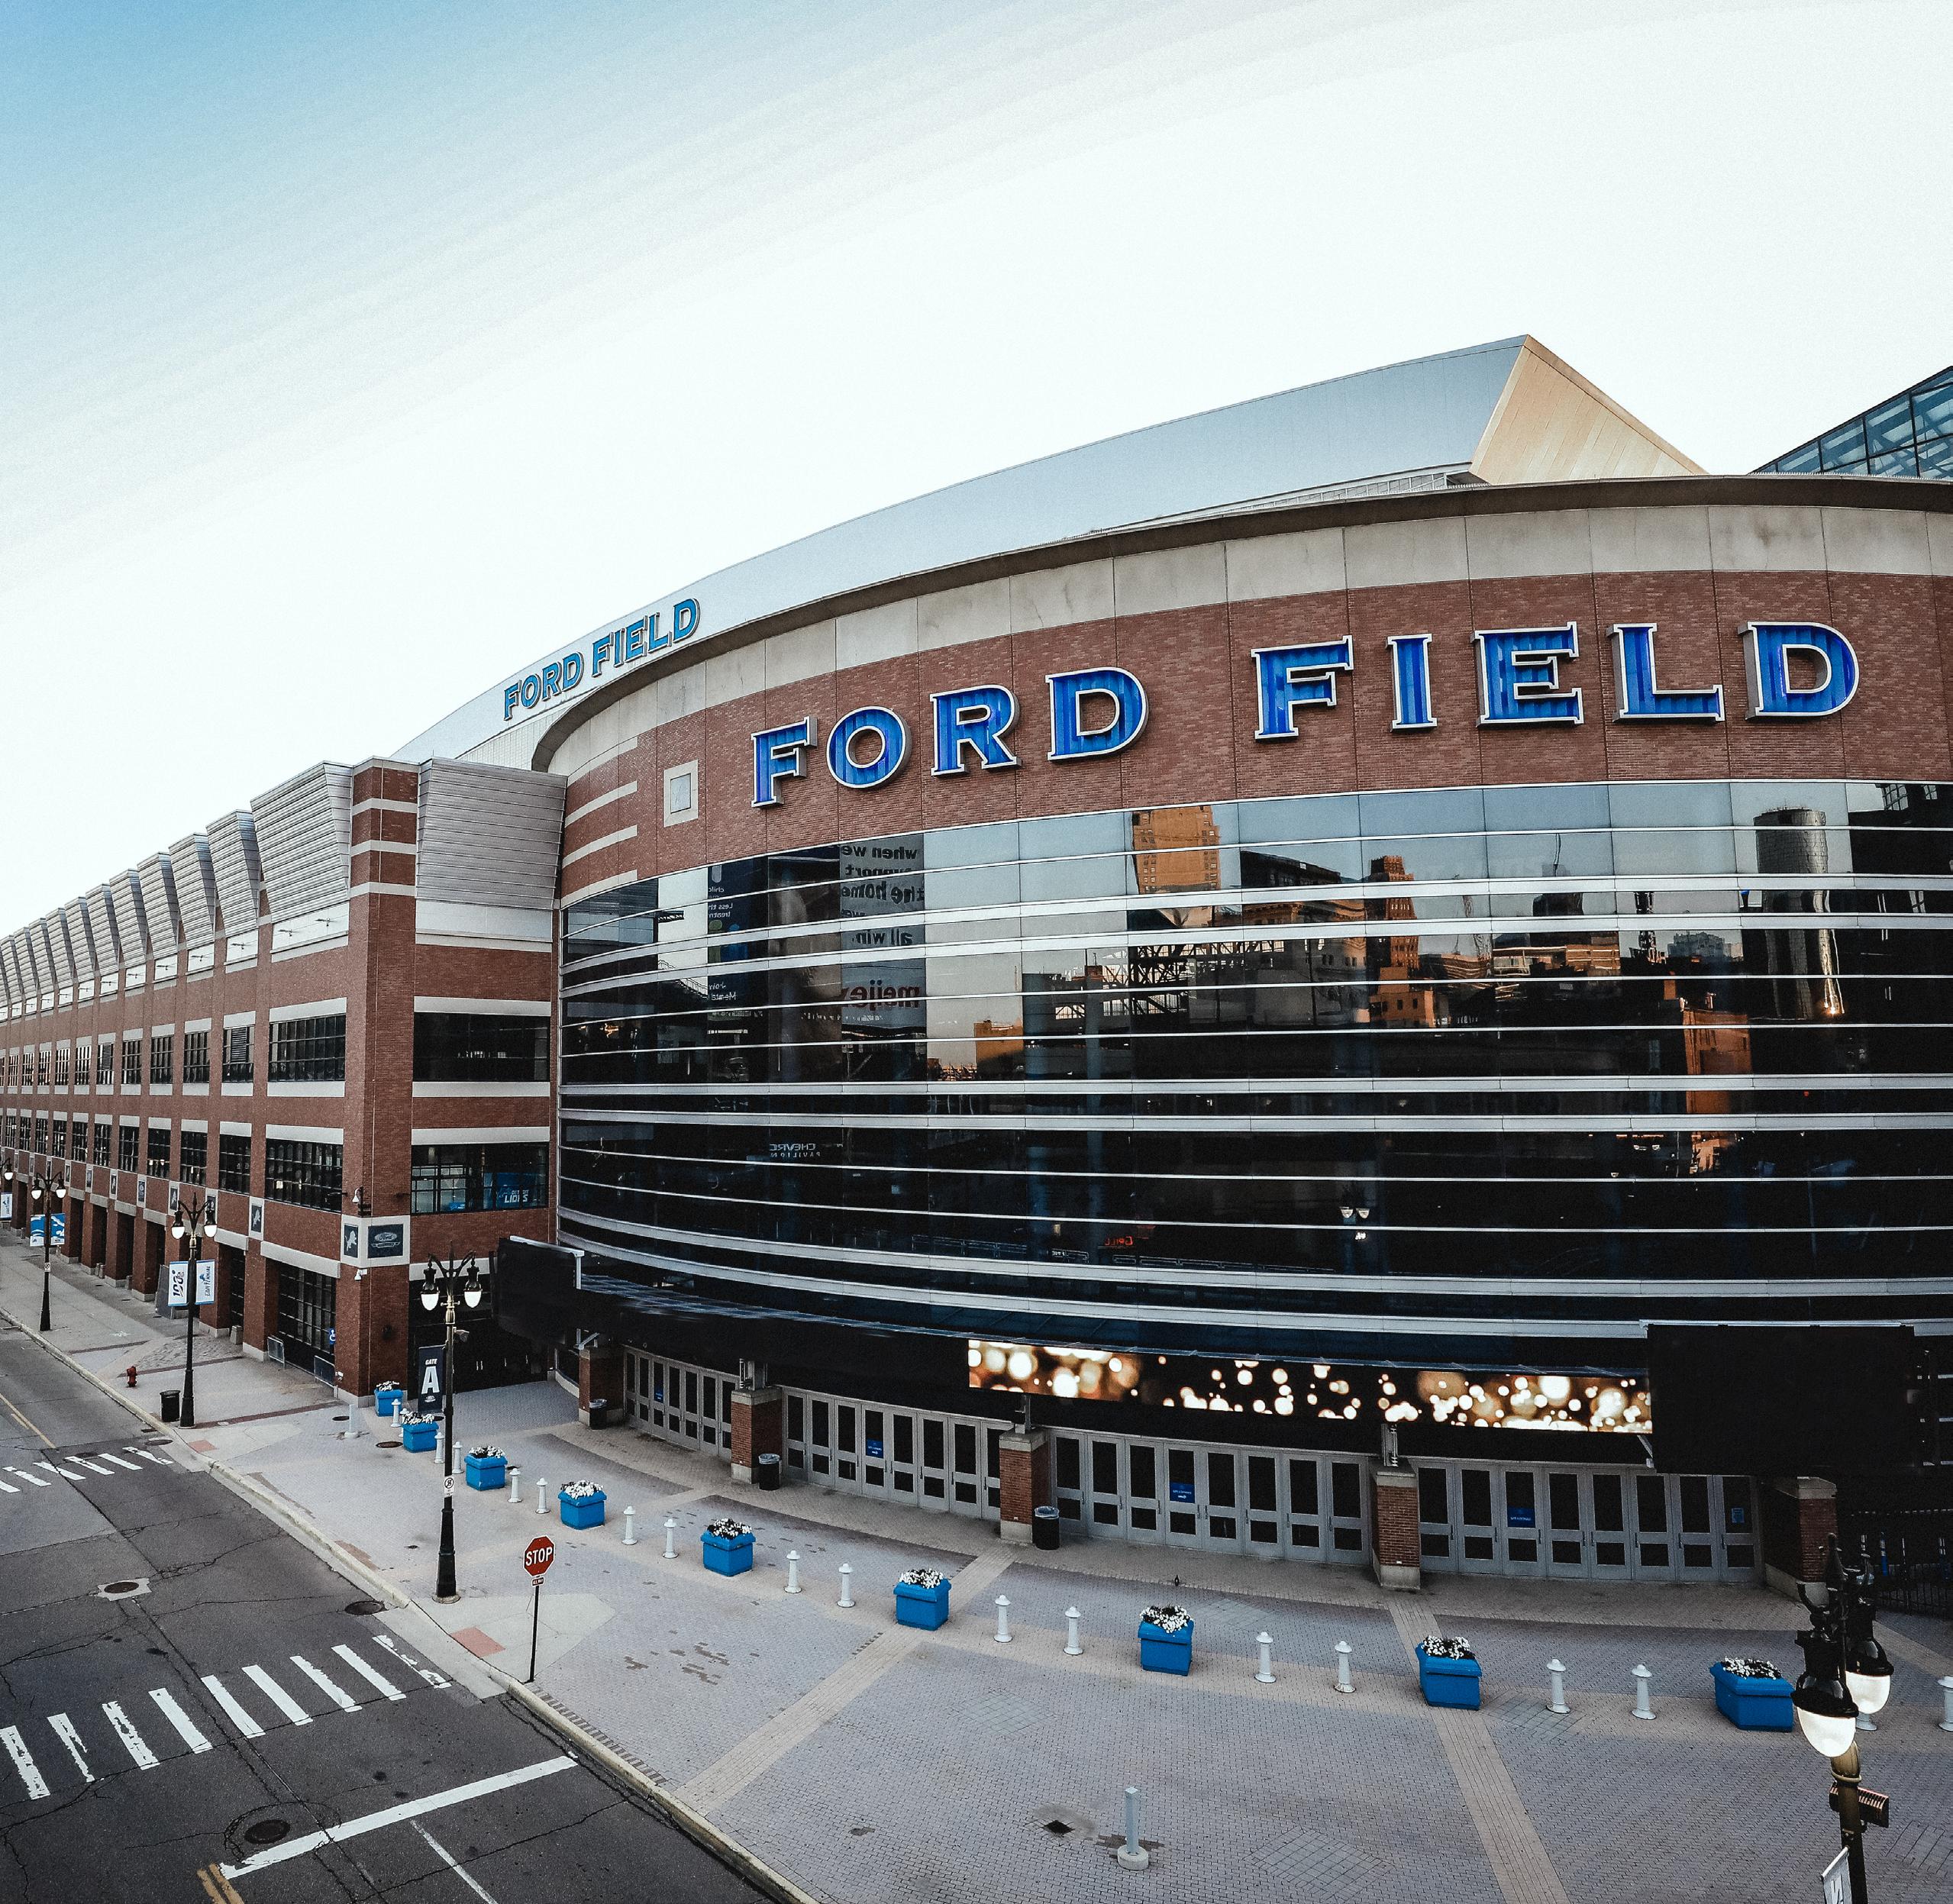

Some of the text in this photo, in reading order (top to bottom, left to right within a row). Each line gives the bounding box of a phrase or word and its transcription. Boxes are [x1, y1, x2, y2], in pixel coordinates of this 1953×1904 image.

[503, 598, 701, 721] FORD FIELD
[751, 621, 1860, 808] FORD FIELD
[421, 1366, 440, 1395] A
[525, 1547, 553, 1567] STOP
